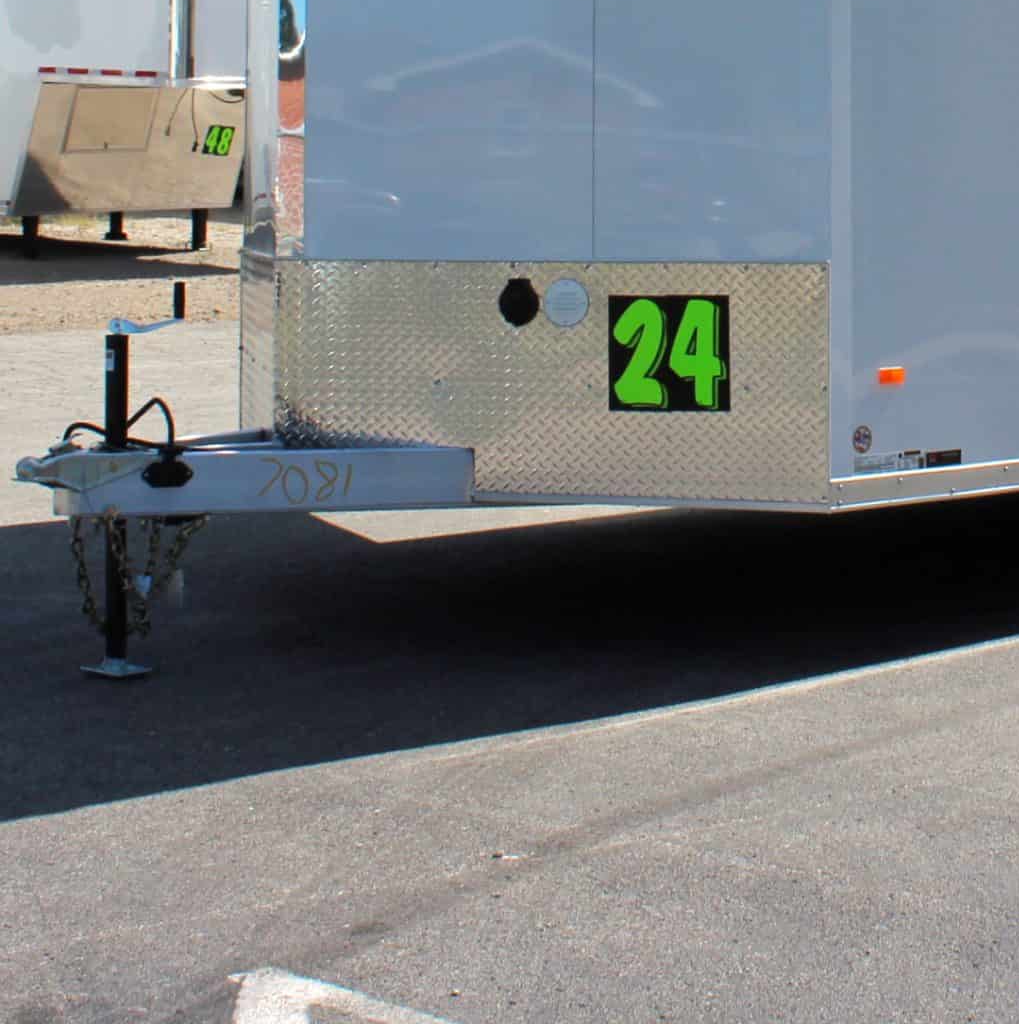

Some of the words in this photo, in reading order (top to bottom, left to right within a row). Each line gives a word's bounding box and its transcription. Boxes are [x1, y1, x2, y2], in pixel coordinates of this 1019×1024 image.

[206, 127, 233, 154] 48
[613, 298, 727, 409] 24
[257, 457, 353, 505] 7081
